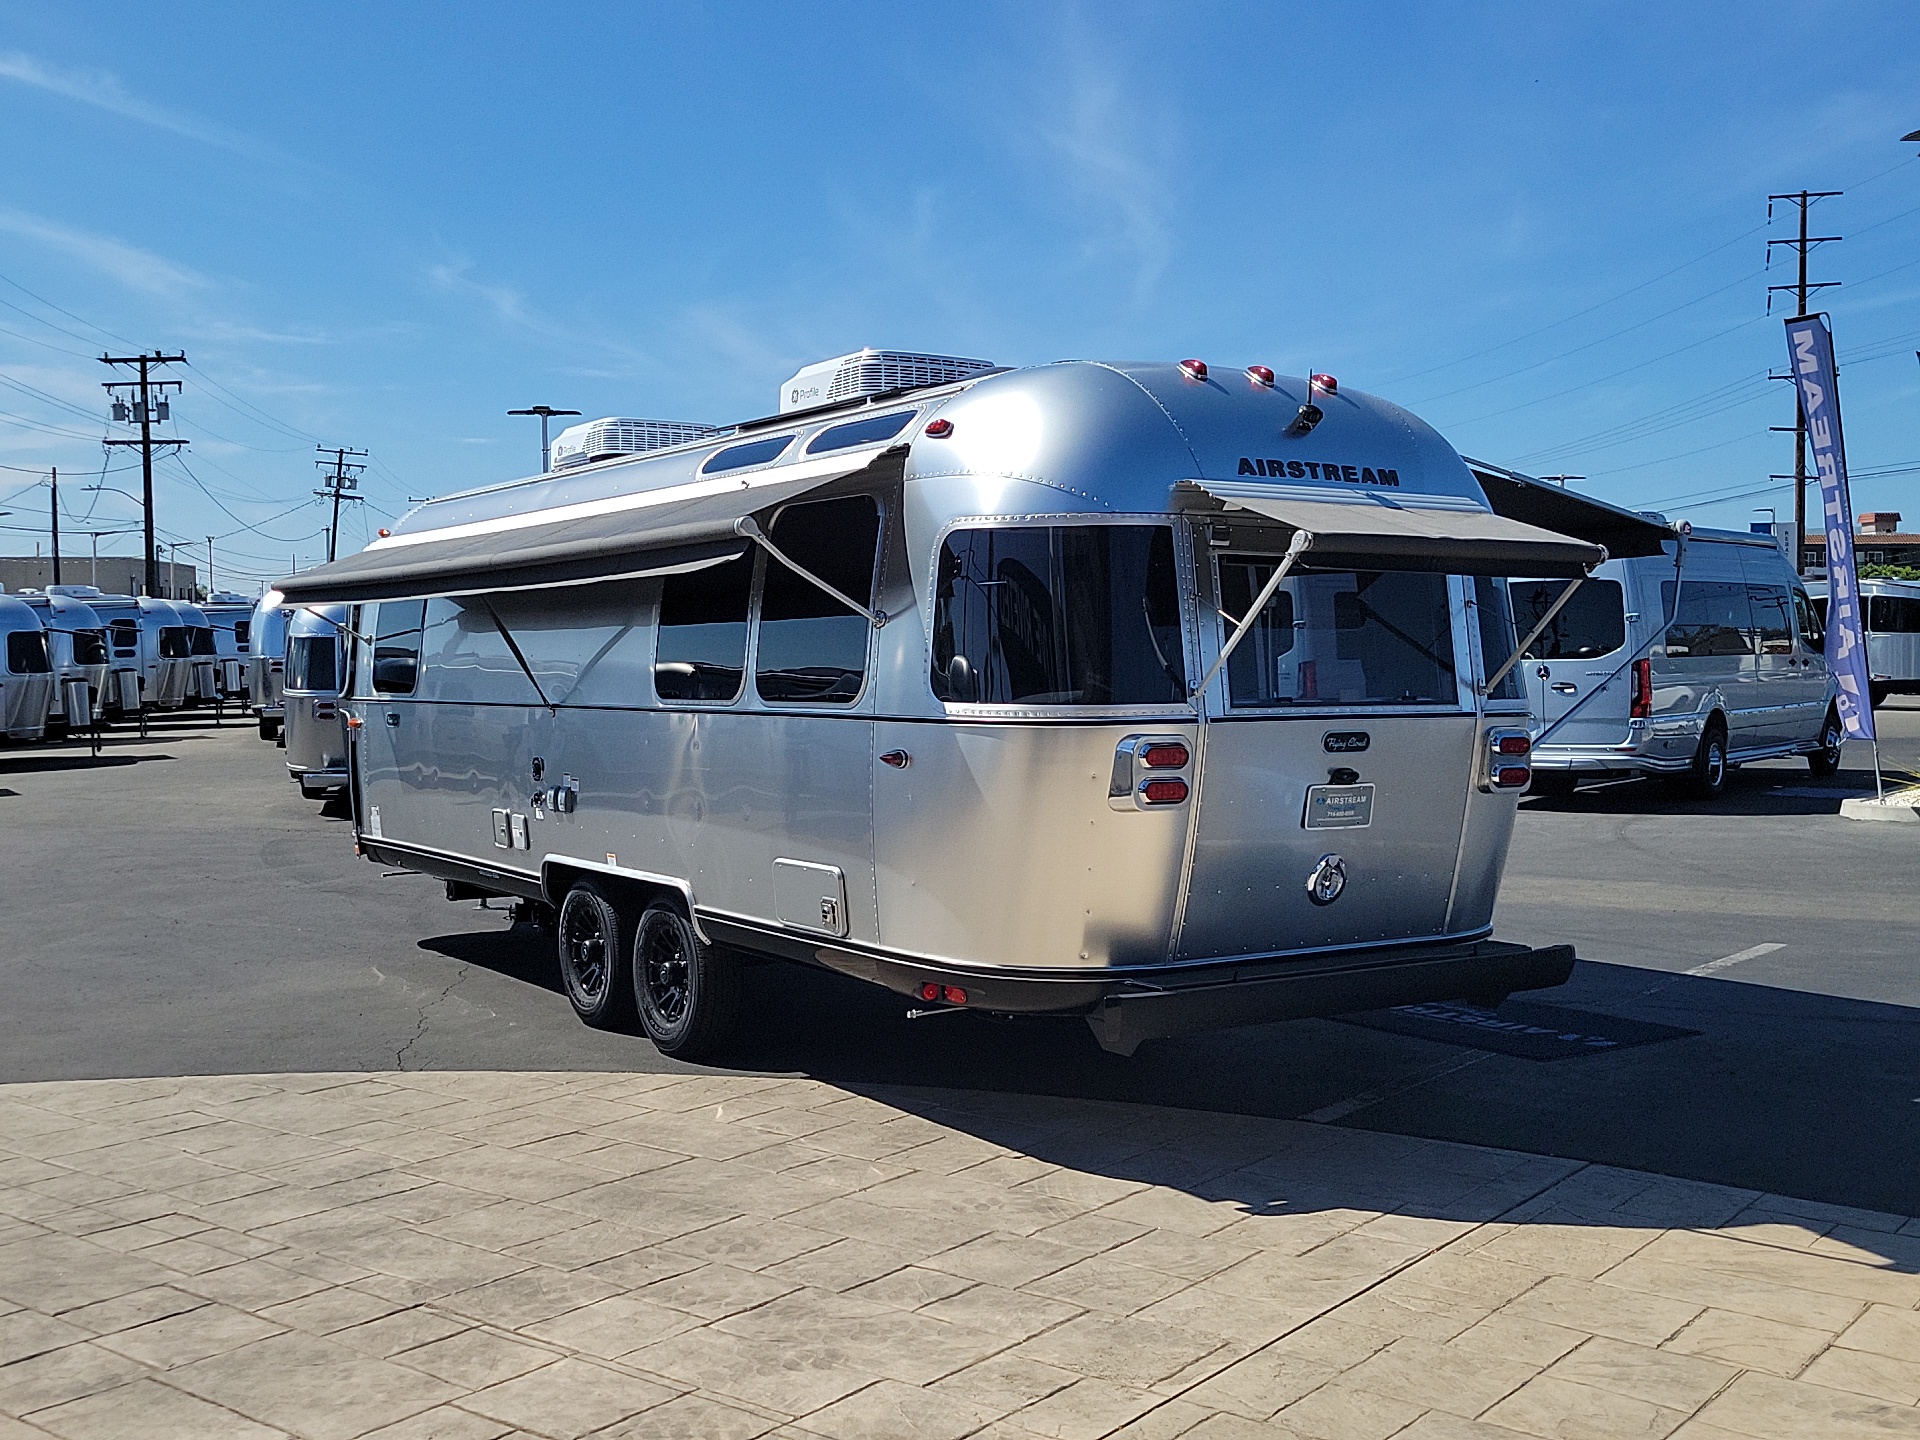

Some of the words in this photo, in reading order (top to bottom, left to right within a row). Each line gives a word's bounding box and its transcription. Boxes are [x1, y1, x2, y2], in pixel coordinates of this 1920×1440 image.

[1237, 457, 1400, 487] AIRSTREAM
[1327, 737, 1347, 751] Flying
[1347, 736, 1367, 747] Cloud
[1326, 796, 1367, 805] AIRSTREAM
